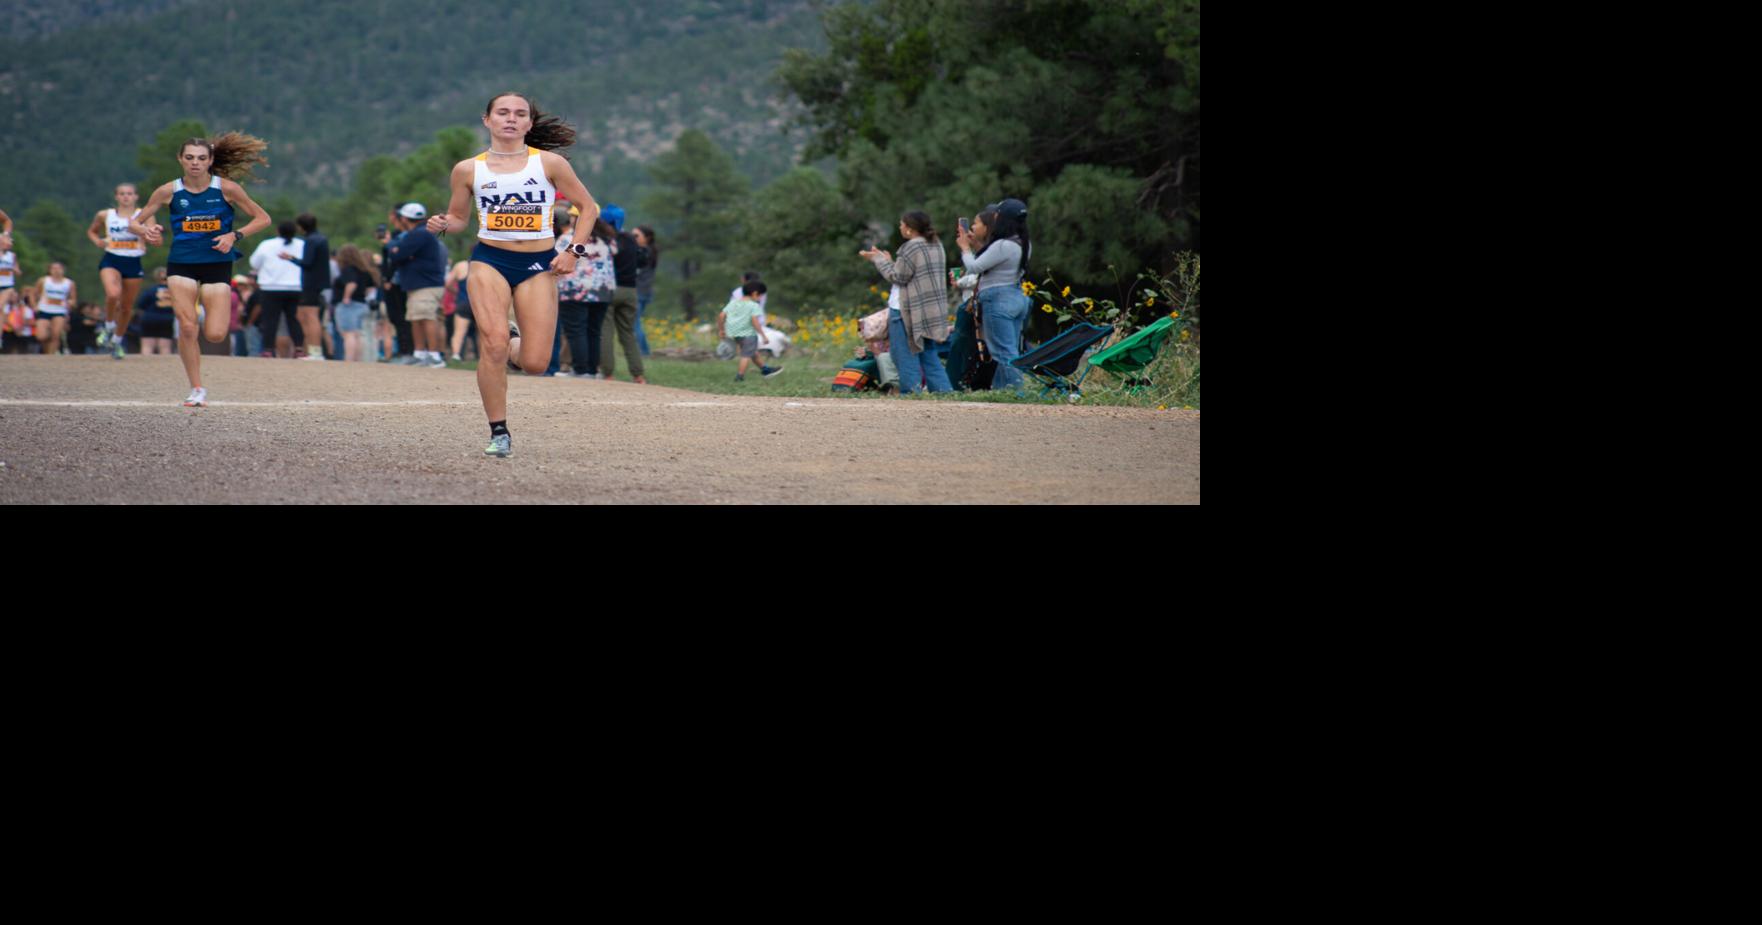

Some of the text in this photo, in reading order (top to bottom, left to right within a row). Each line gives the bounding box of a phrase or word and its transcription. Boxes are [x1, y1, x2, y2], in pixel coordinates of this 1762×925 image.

[480, 190, 546, 208] NAU
[187, 221, 216, 231] 4942
[494, 215, 535, 228] 5002
